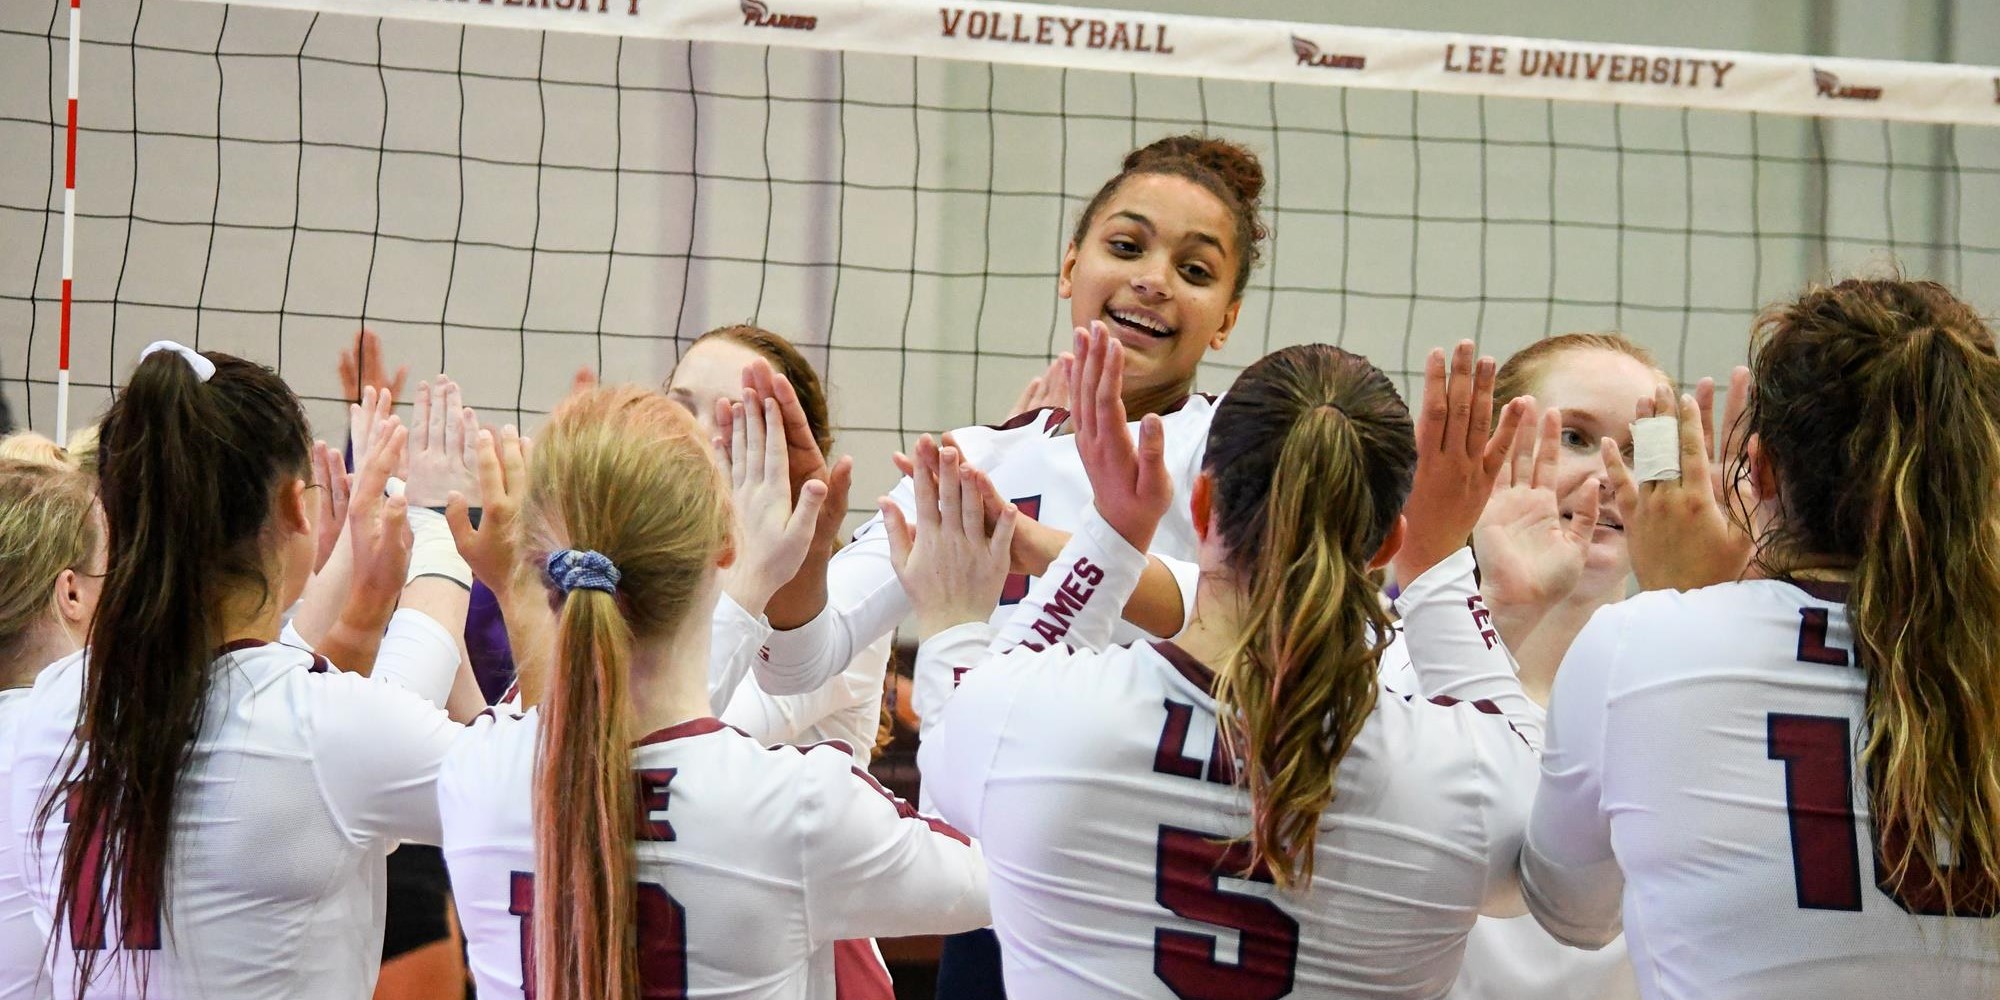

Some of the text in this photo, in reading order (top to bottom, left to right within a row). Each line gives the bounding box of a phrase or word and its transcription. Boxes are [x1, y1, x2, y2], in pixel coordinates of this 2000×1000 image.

[939, 8, 1174, 54] VOLLEYBALL
[1444, 44, 1735, 89] LEE UNIVERSITY
[1005, 556, 1104, 654] AMES
[1153, 823, 1299, 1000] 5
